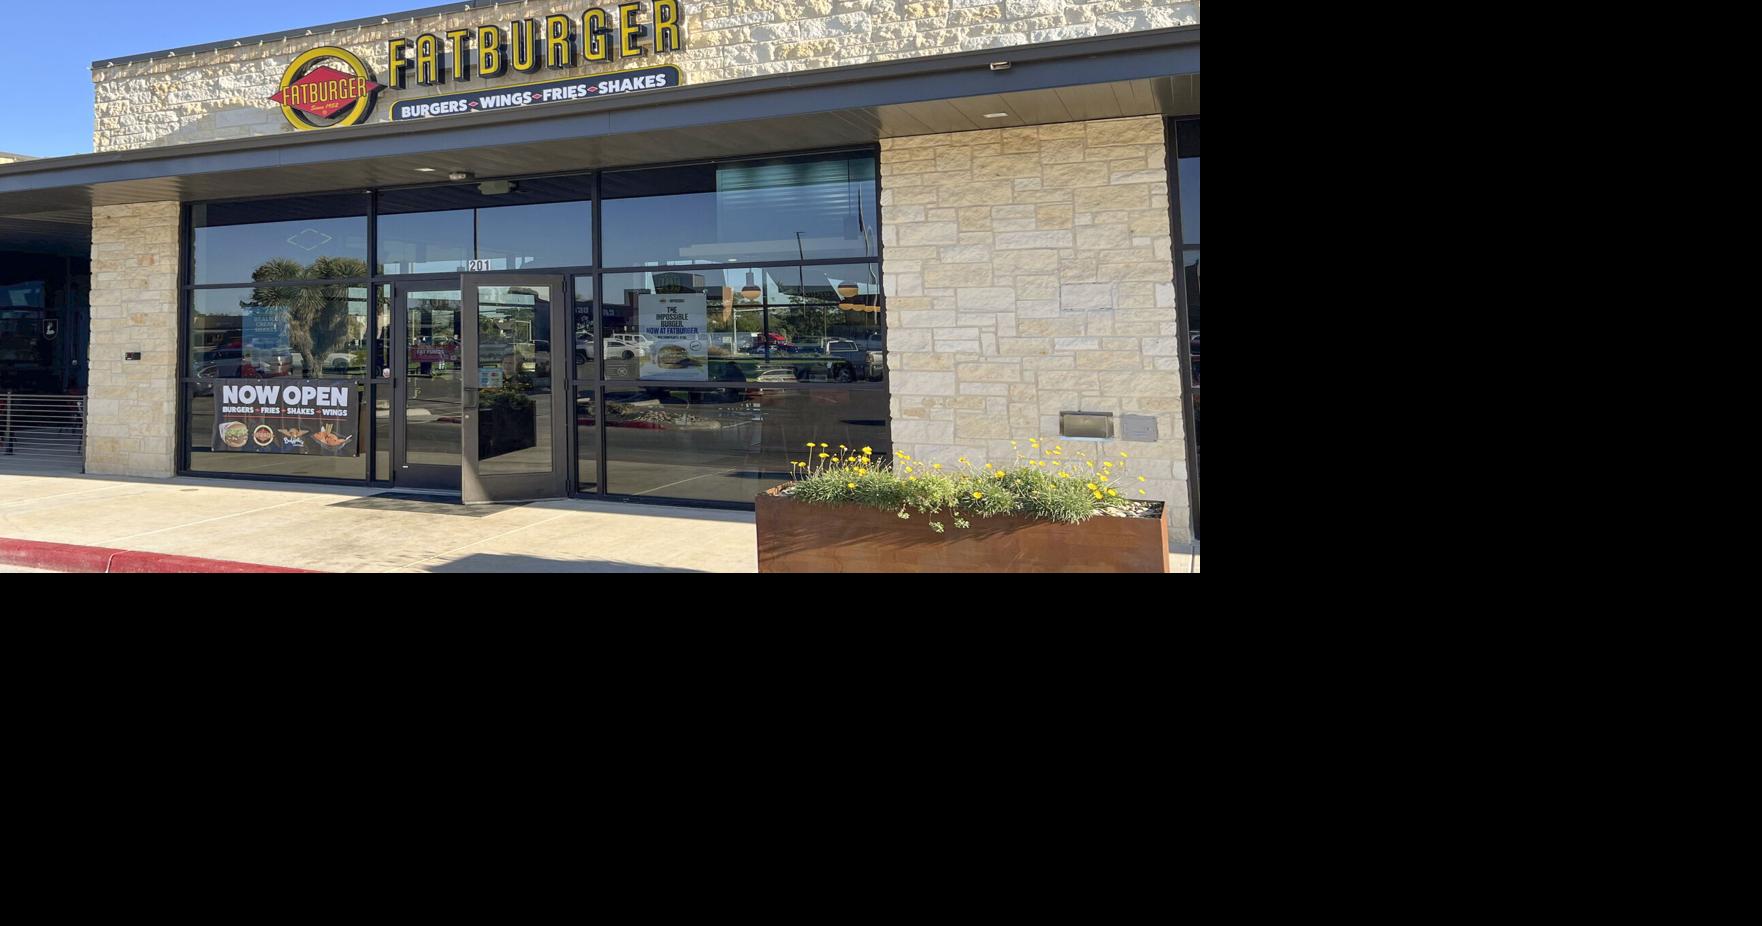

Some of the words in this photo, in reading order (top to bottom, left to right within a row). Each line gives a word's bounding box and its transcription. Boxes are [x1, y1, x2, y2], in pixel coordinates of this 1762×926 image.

[388, 0, 681, 89] FATBURGER
[282, 76, 367, 106] FATBURGER
[401, 99, 468, 118] BURGERS
[479, 91, 533, 109] WINGS
[542, 84, 587, 101] FRIES
[598, 73, 667, 94] SHAKES
[469, 260, 490, 271] 201
[656, 313, 689, 321] IMPOSSIBLE
[222, 385, 280, 405] NOW
[282, 386, 349, 407] OPEN
[222, 406, 254, 414] BURGERS
[260, 406, 280, 414] FRIES
[287, 408, 315, 416] SHAKES
